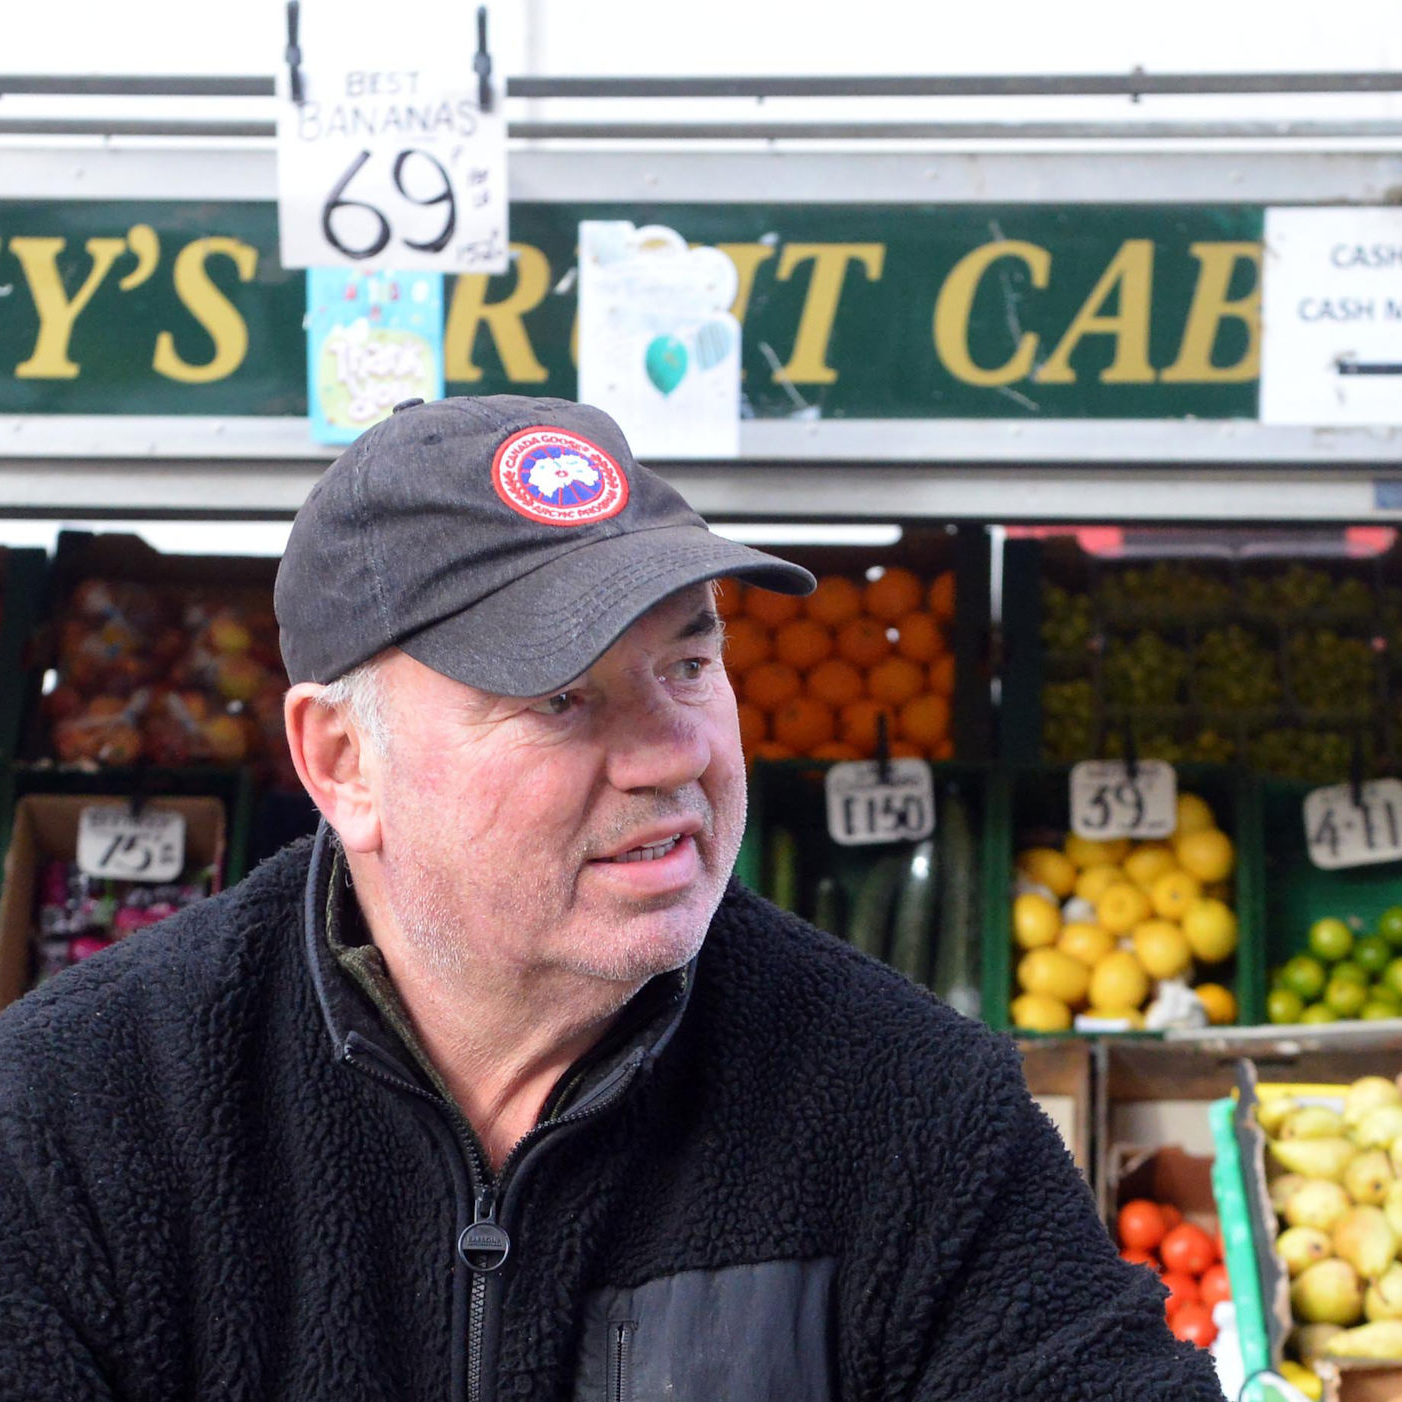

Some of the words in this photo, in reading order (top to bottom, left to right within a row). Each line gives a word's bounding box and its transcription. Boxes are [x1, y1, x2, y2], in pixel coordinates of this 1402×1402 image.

[346, 71, 420, 96] BEST
[298, 100, 478, 142] BANANAS
[322, 149, 455, 259] 69
[1297, 298, 1380, 323] CASH
[505, 437, 540, 469] CANADA
